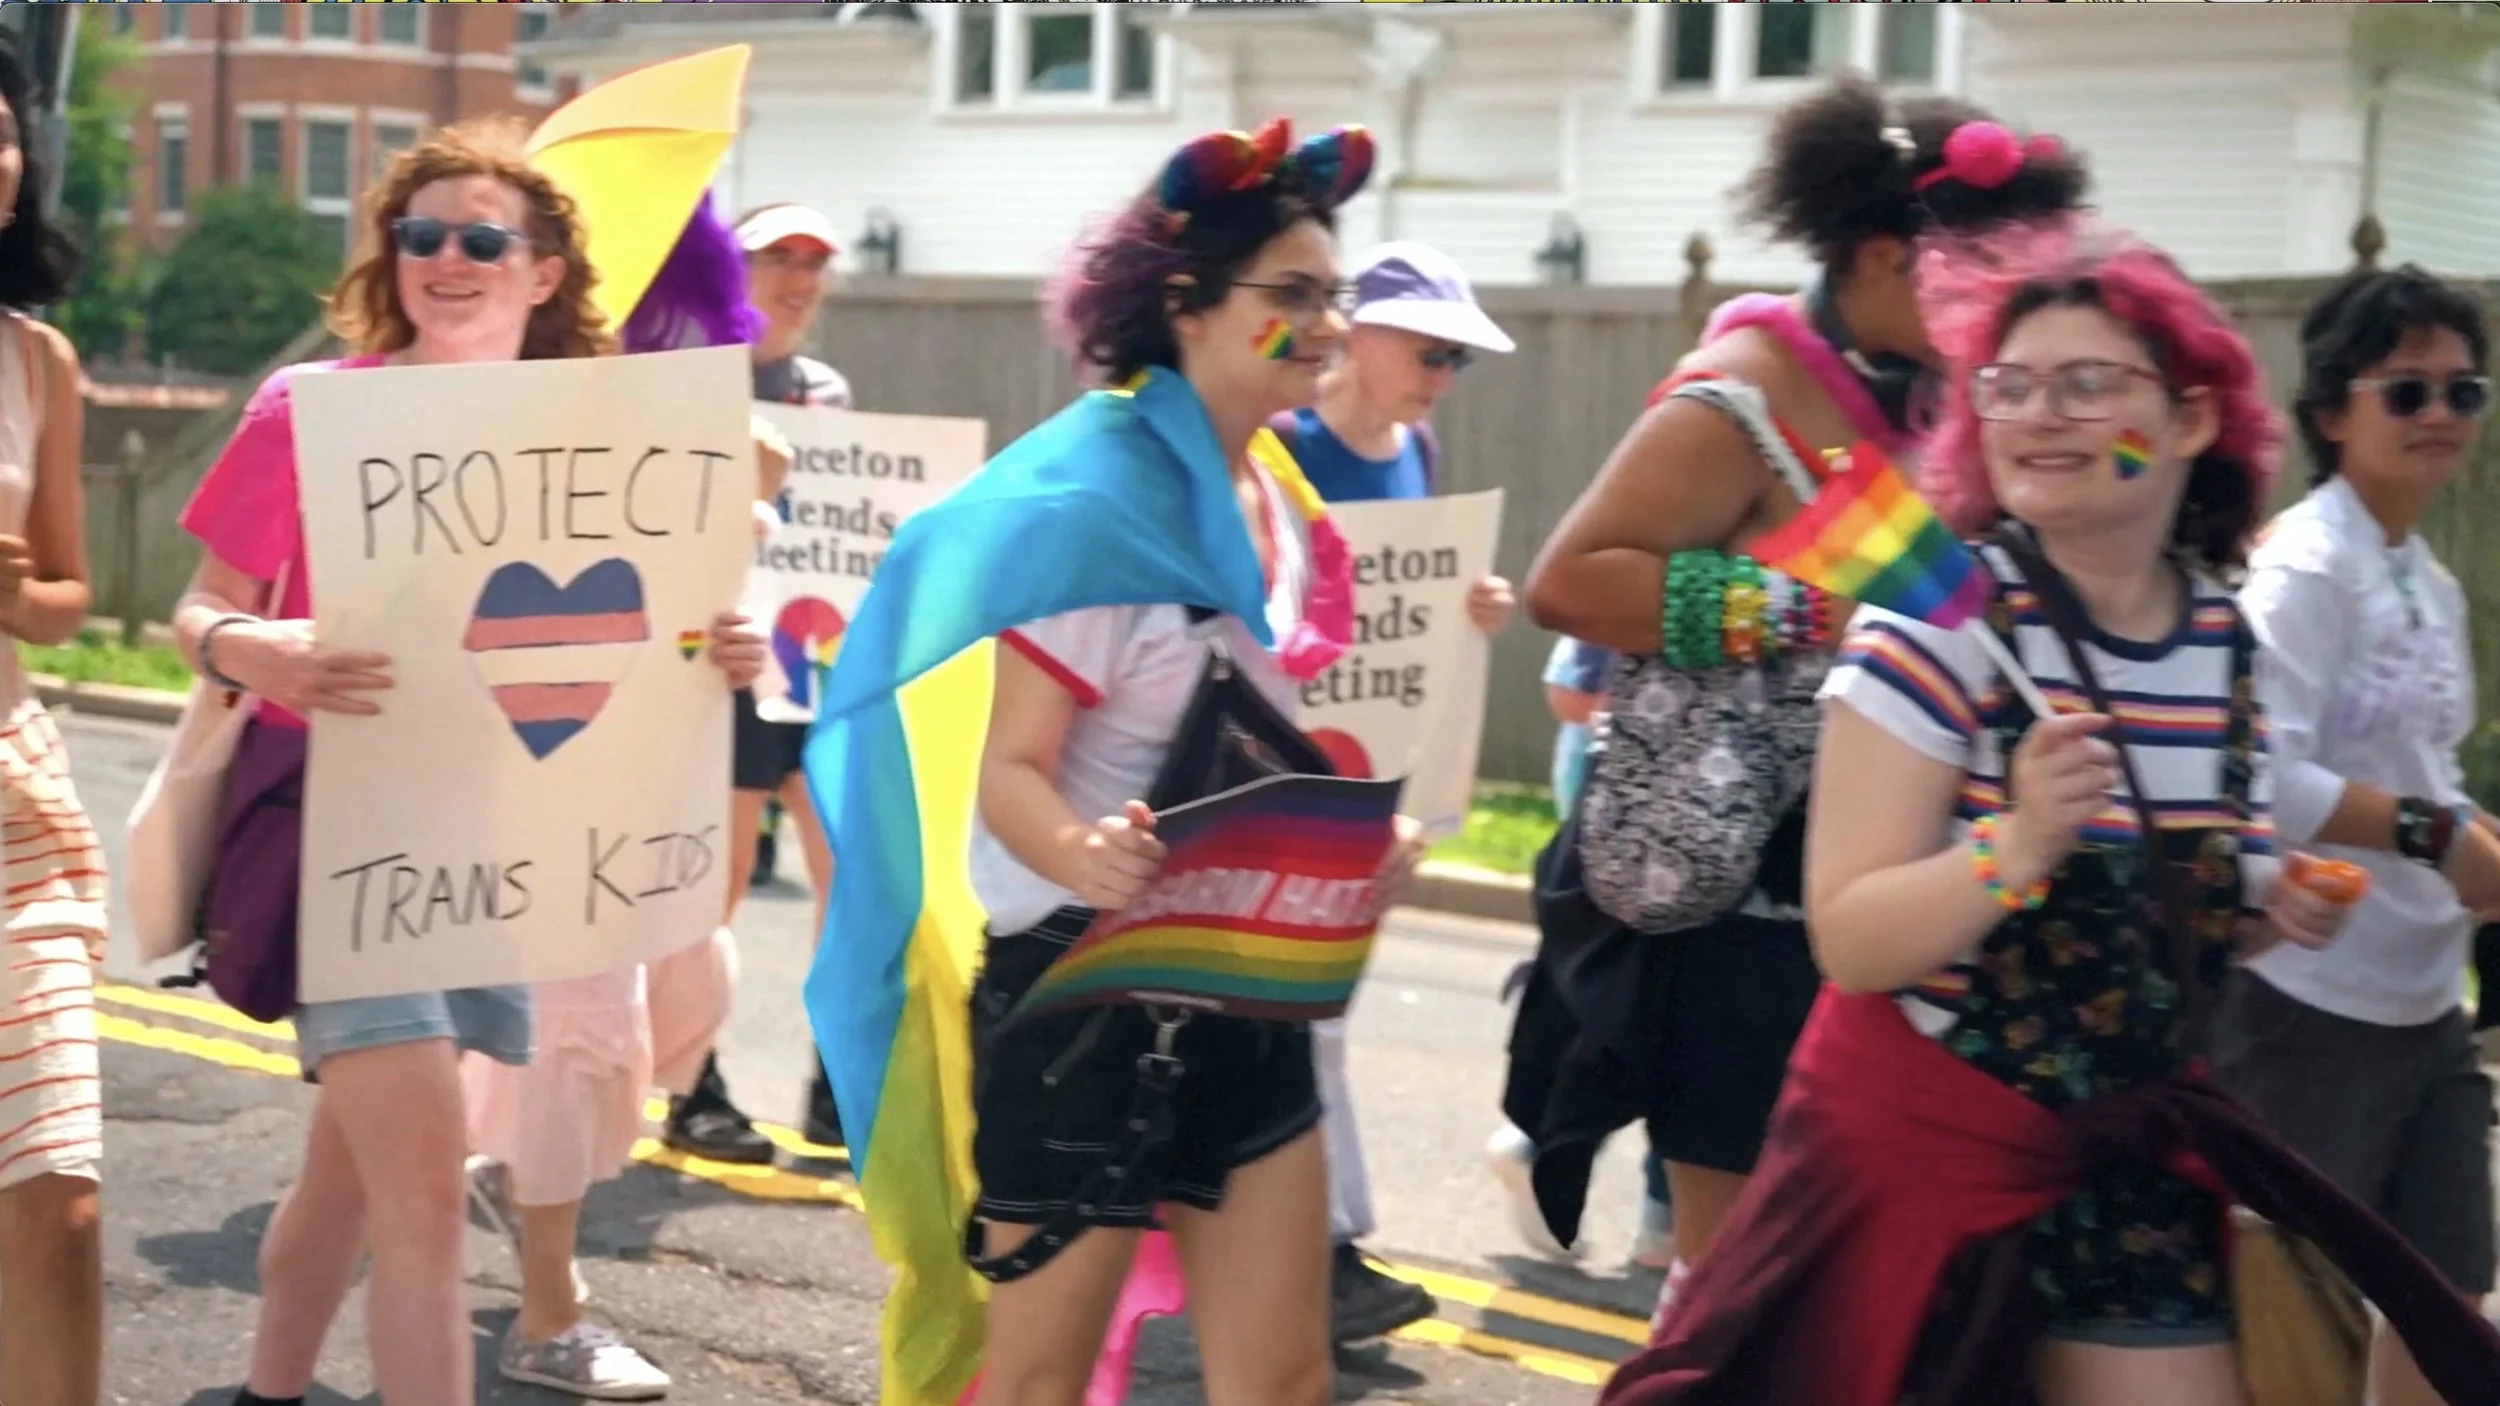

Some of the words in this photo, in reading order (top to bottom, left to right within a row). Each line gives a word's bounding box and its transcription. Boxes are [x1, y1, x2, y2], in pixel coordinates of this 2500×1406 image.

[357, 446, 736, 559] PROTECT
[329, 852, 535, 953] TRANS
[584, 824, 719, 926] KIDS
